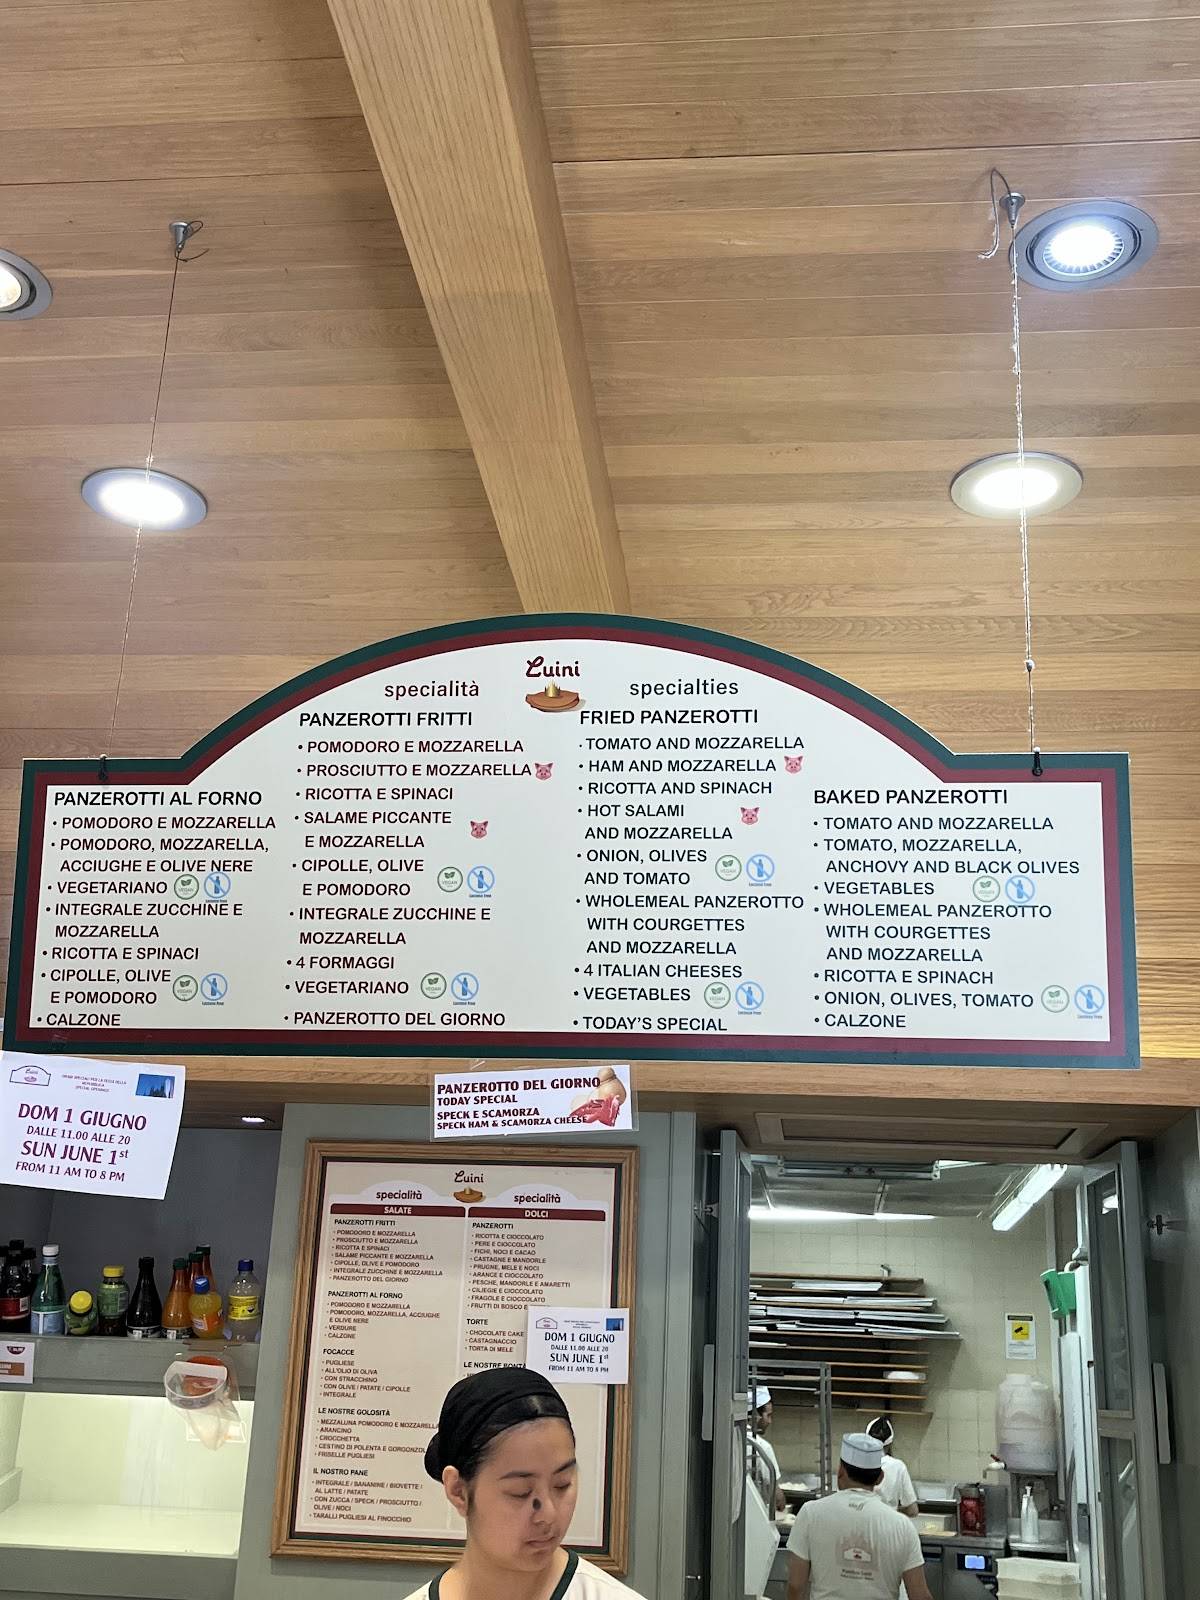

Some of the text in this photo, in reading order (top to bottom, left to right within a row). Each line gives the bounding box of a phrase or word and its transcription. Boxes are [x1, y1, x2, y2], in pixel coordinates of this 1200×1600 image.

[526, 656, 580, 677] Luini
[385, 680, 479, 700] specialità
[630, 678, 738, 699] specialties
[300, 712, 471, 726] PANZEROTTI FRITTI
[581, 709, 757, 724] FRIED PANZEROTTI
[308, 740, 523, 753] POMODORO E MOZZARELLA
[586, 737, 804, 750] TOMATO AND MOZZARELLA
[307, 764, 531, 776] PROSCIUTTO E MOZZARELLA
[589, 760, 776, 772] HAM AND MOZZARELLA
[306, 788, 452, 800] RICOTTA E SPINACI
[589, 782, 771, 794] RICOTTA AND SPINACH
[55, 791, 261, 806] PANZEROTTI AL FORNO
[815, 790, 1007, 804] BAKED PANZEROTTI
[588, 805, 683, 816] HOT SALAMI
[304, 812, 451, 823] SALAME PICCANTE
[585, 827, 732, 839] AND MOZZARELLA
[61, 838, 268, 852] POMODORO, MOZZARELLA,
[305, 836, 424, 847] E MOZZARELLA
[824, 839, 1021, 854] TOMATO, MOZZARELLA,
[587, 850, 707, 864] ONION, OLIVES
[60, 860, 253, 873] ACCIUGHE E OLIVE NERE
[302, 860, 424, 874] CIPOLLE, OLIVE
[826, 860, 1079, 873] ANCHOVY AND BLACK OLIVES
[584, 872, 690, 884] AND TOMATO
[57, 882, 167, 893] VEGETARIANO
[303, 884, 410, 896] E POMODORO
[586, 895, 803, 908] WHOLEMEAL PANZEROTTO
[300, 908, 490, 920] INTEGRALE ZUCCHINE E
[587, 918, 744, 931] WITH COURGETTES
[300, 932, 406, 944] MOZZARELLA
[587, 941, 736, 954] AND MOZZARELLA
[296, 956, 394, 969] 4 FORMAGGI
[584, 964, 742, 978] 4 ITALIAN CHEESES
[825, 970, 993, 984] RICOTTA E SPINACH
[295, 981, 408, 994] VEGETARIANO
[584, 987, 690, 1001] VEGETABLES
[825, 992, 1033, 1008] ONION, OLIVES, TOMATO
[46, 1014, 121, 1026] CALZONE
[294, 1012, 505, 1026] PANZEROTTO DEL GIORNO
[657, 1018, 727, 1031] SPECIAL
[825, 1014, 906, 1027] CALZONE
[438, 1077, 601, 1094] PANZEROTTO DEL GIORNO
[437, 1095, 518, 1106] TODAY SPECIAL
[18, 1104, 146, 1130] DOM 1 GIUGNO
[437, 1111, 470, 1120] SPECK
[482, 1108, 540, 1118] SCAMORZA
[501, 1118, 551, 1127] SCAMORZA
[554, 1115, 588, 1124] CHEESE
[27, 1126, 130, 1144] DALLE 11.00 ALLE 20
[21, 1141, 57, 1158] SUN
[60, 1145, 103, 1163] JUNE
[15, 1161, 125, 1182] FROM 11 AM TO 8 PM
[454, 1170, 484, 1183] Luini
[376, 1190, 422, 1201] specialità
[514, 1193, 561, 1205] specialità
[384, 1206, 412, 1214] SALATE
[524, 1210, 548, 1218] DOLCI
[544, 1332, 615, 1343] DOM 1 GIUGNO
